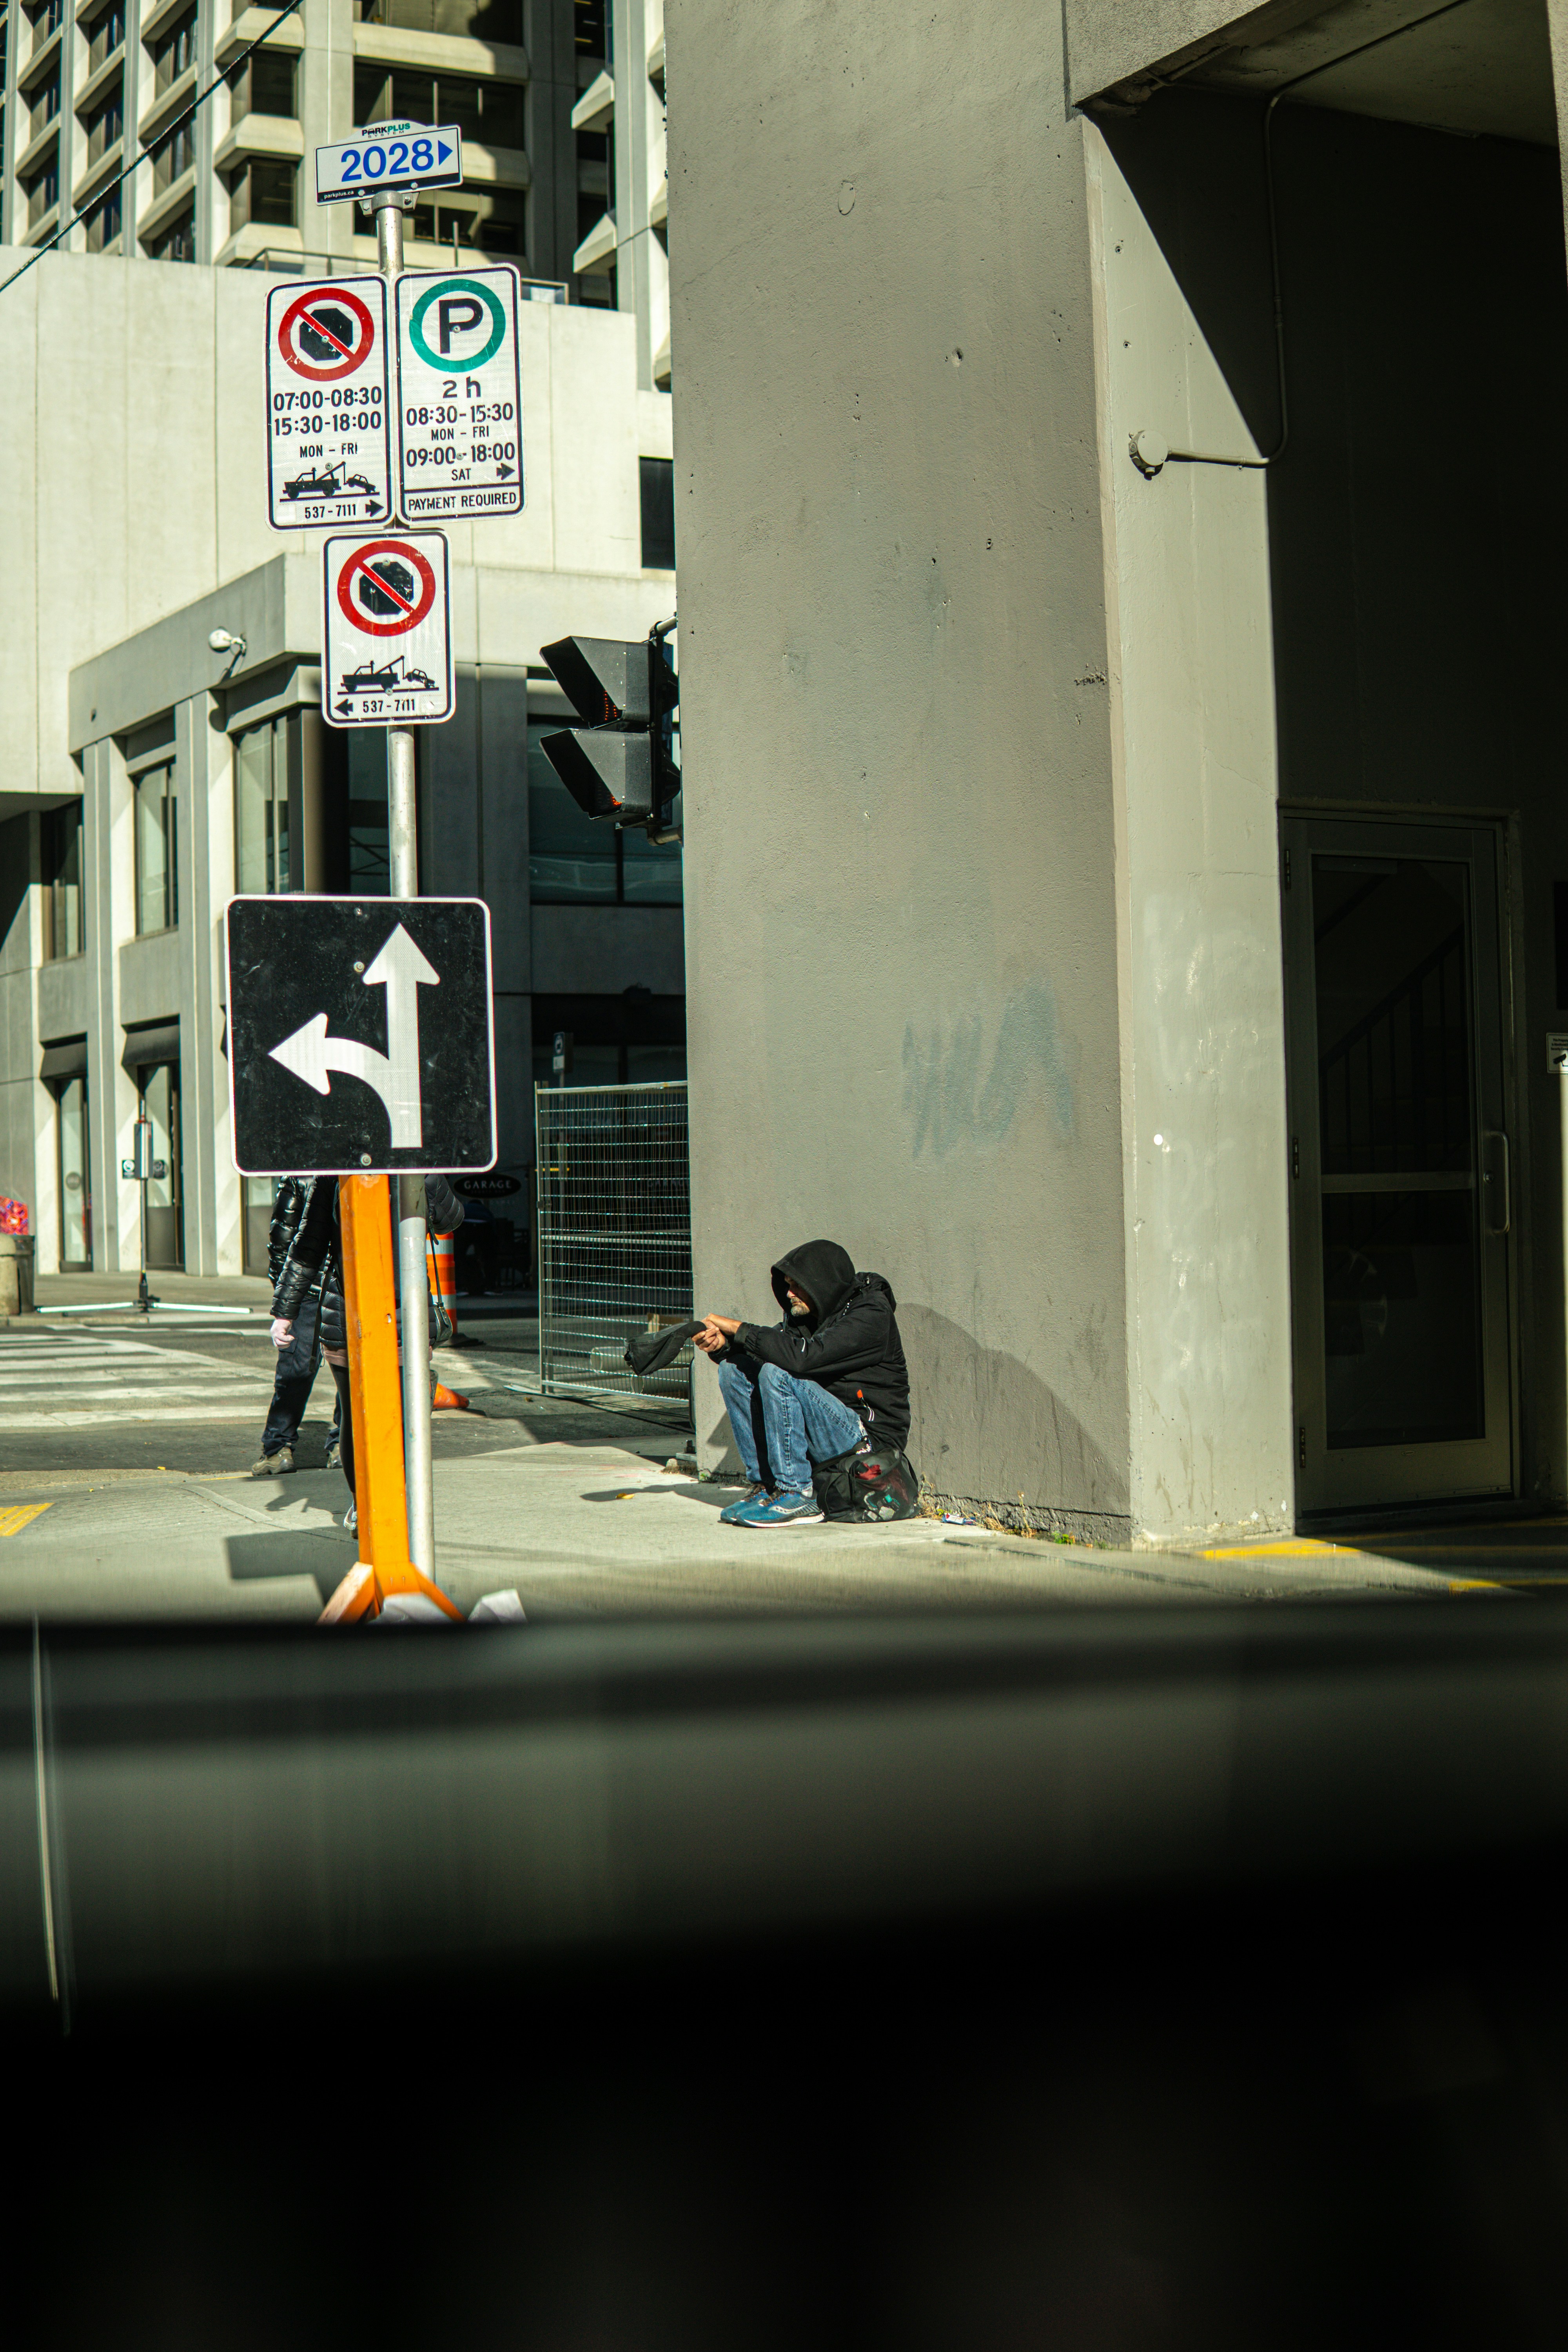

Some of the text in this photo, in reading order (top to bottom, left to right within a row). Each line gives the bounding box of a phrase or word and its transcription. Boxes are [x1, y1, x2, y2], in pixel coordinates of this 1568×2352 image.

[341, 139, 434, 182] 2028
[324, 191, 354, 200] parkplus.ca
[439, 298, 483, 354] P
[443, 376, 481, 398] 2 h
[274, 386, 382, 411] 07:00-08:30
[275, 411, 381, 436] 15:30-18:00
[431, 428, 454, 441] MON
[473, 426, 489, 438] FRI
[300, 445, 323, 458] MON
[341, 443, 358, 455] FRI
[452, 468, 471, 481] SAT
[408, 492, 516, 510] PAYMENT REQUIRED
[305, 504, 356, 519] 537-7111
[464, 1180, 512, 1189] GARAGE
